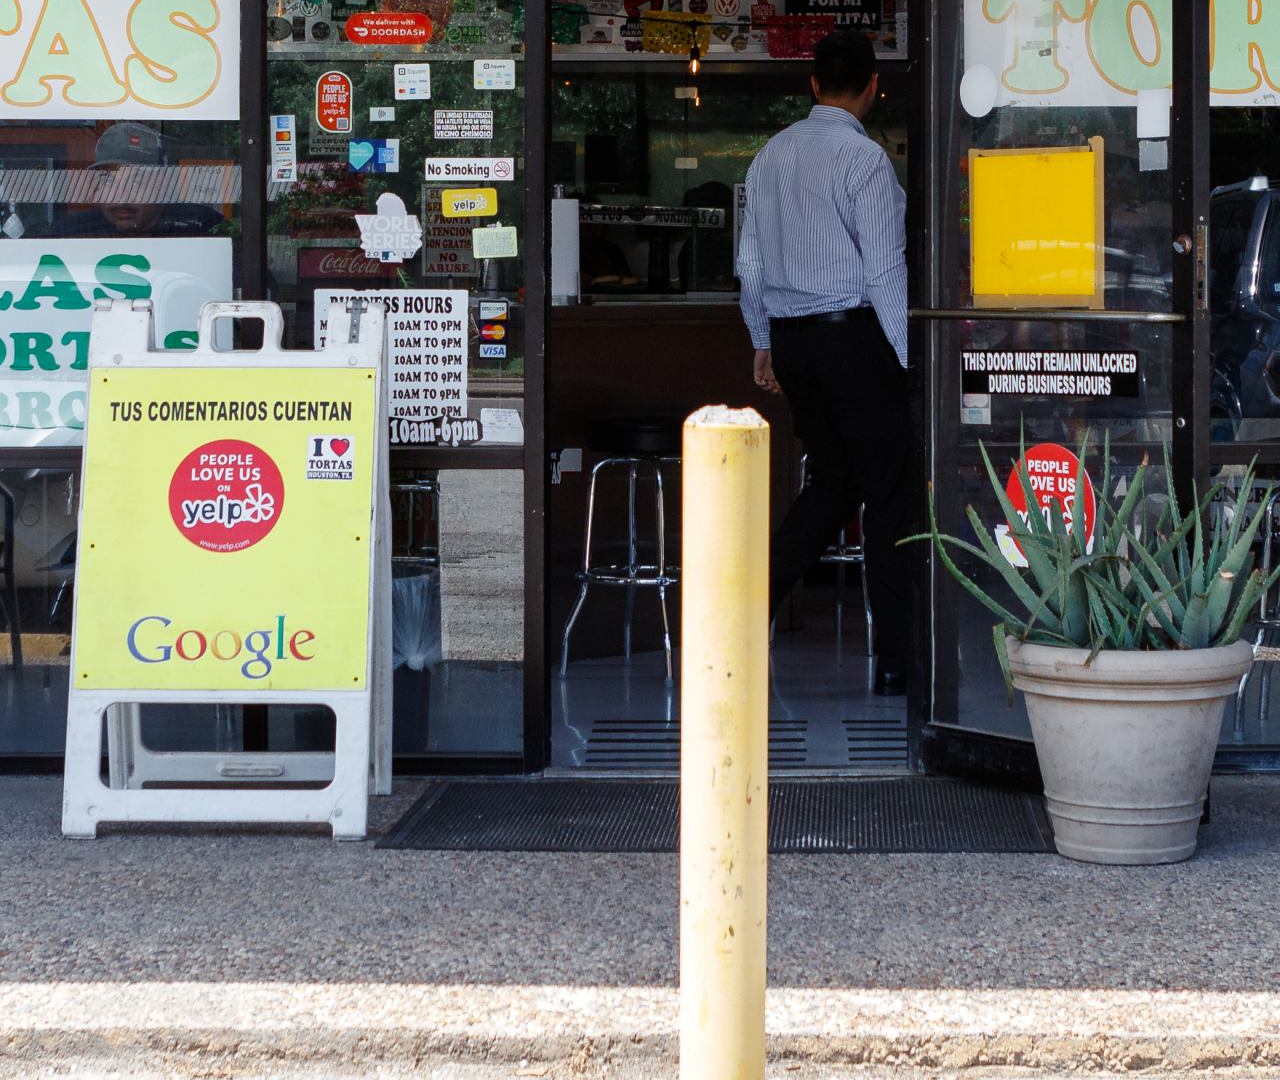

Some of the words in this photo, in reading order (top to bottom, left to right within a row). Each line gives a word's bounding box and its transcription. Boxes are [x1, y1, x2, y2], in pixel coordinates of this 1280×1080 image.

[362, 18, 374, 26] We
[375, 18, 399, 26] deliver
[400, 18, 416, 26] with
[371, 28, 425, 36] DOORDASH
[322, 84, 347, 93] PEOPLE
[322, 93, 337, 103] LOVE
[338, 94, 347, 103] US
[322, 107, 339, 116] yelp
[427, 164, 441, 176] No
[444, 163, 490, 179] Smoking
[453, 199, 476, 211] yelp
[439, 253, 458, 261] NO
[427, 264, 471, 272] ABUSE
[404, 296, 452, 313] HOURS
[394, 320, 421, 331] 10AM
[424, 320, 438, 331] TO
[441, 320, 462, 332] 9PM
[394, 337, 421, 348] 10AM
[424, 337, 438, 348] TO
[441, 337, 462, 349] 9PM
[483, 346, 505, 356] VISA
[394, 355, 422, 366] 10AM
[424, 355, 439, 366] TO
[442, 355, 462, 367] 9PM
[963, 352, 986, 371] THIS
[986, 353, 1013, 371] DOOR
[1015, 353, 1042, 371] MUST
[1043, 353, 1081, 372] REMAIN
[1082, 353, 1136, 373] UNLOCKED
[394, 372, 421, 383] 10AM
[424, 372, 438, 383] TO
[441, 372, 462, 384] 9PM
[988, 375, 1026, 393] DURING
[1027, 375, 1075, 395] BUSINESS
[1076, 375, 1111, 395] HOURS
[392, 389, 420, 400] 10AM
[423, 389, 438, 400] TO
[440, 389, 461, 401] 9PM
[110, 401, 142, 422] TUS
[148, 400, 268, 421] COMENTARIOS
[273, 400, 352, 421] CUENTAN
[394, 406, 421, 417] 10AM
[424, 406, 438, 417] TO
[441, 406, 462, 418] 9PM
[389, 419, 479, 447] 10am-6pm
[313, 438, 323, 457] I
[199, 454, 254, 466] PEOPLE
[308, 459, 352, 470] TORTAS
[1028, 459, 1069, 474] PEOPLE
[191, 468, 235, 481] LOVE
[239, 467, 261, 481] US
[217, 484, 231, 493] ON
[1030, 476, 1055, 492] OVE
[1059, 477, 1076, 493] US
[183, 496, 243, 527] yelp
[199, 539, 251, 552] www.yelp.com
[127, 614, 315, 679] Google
